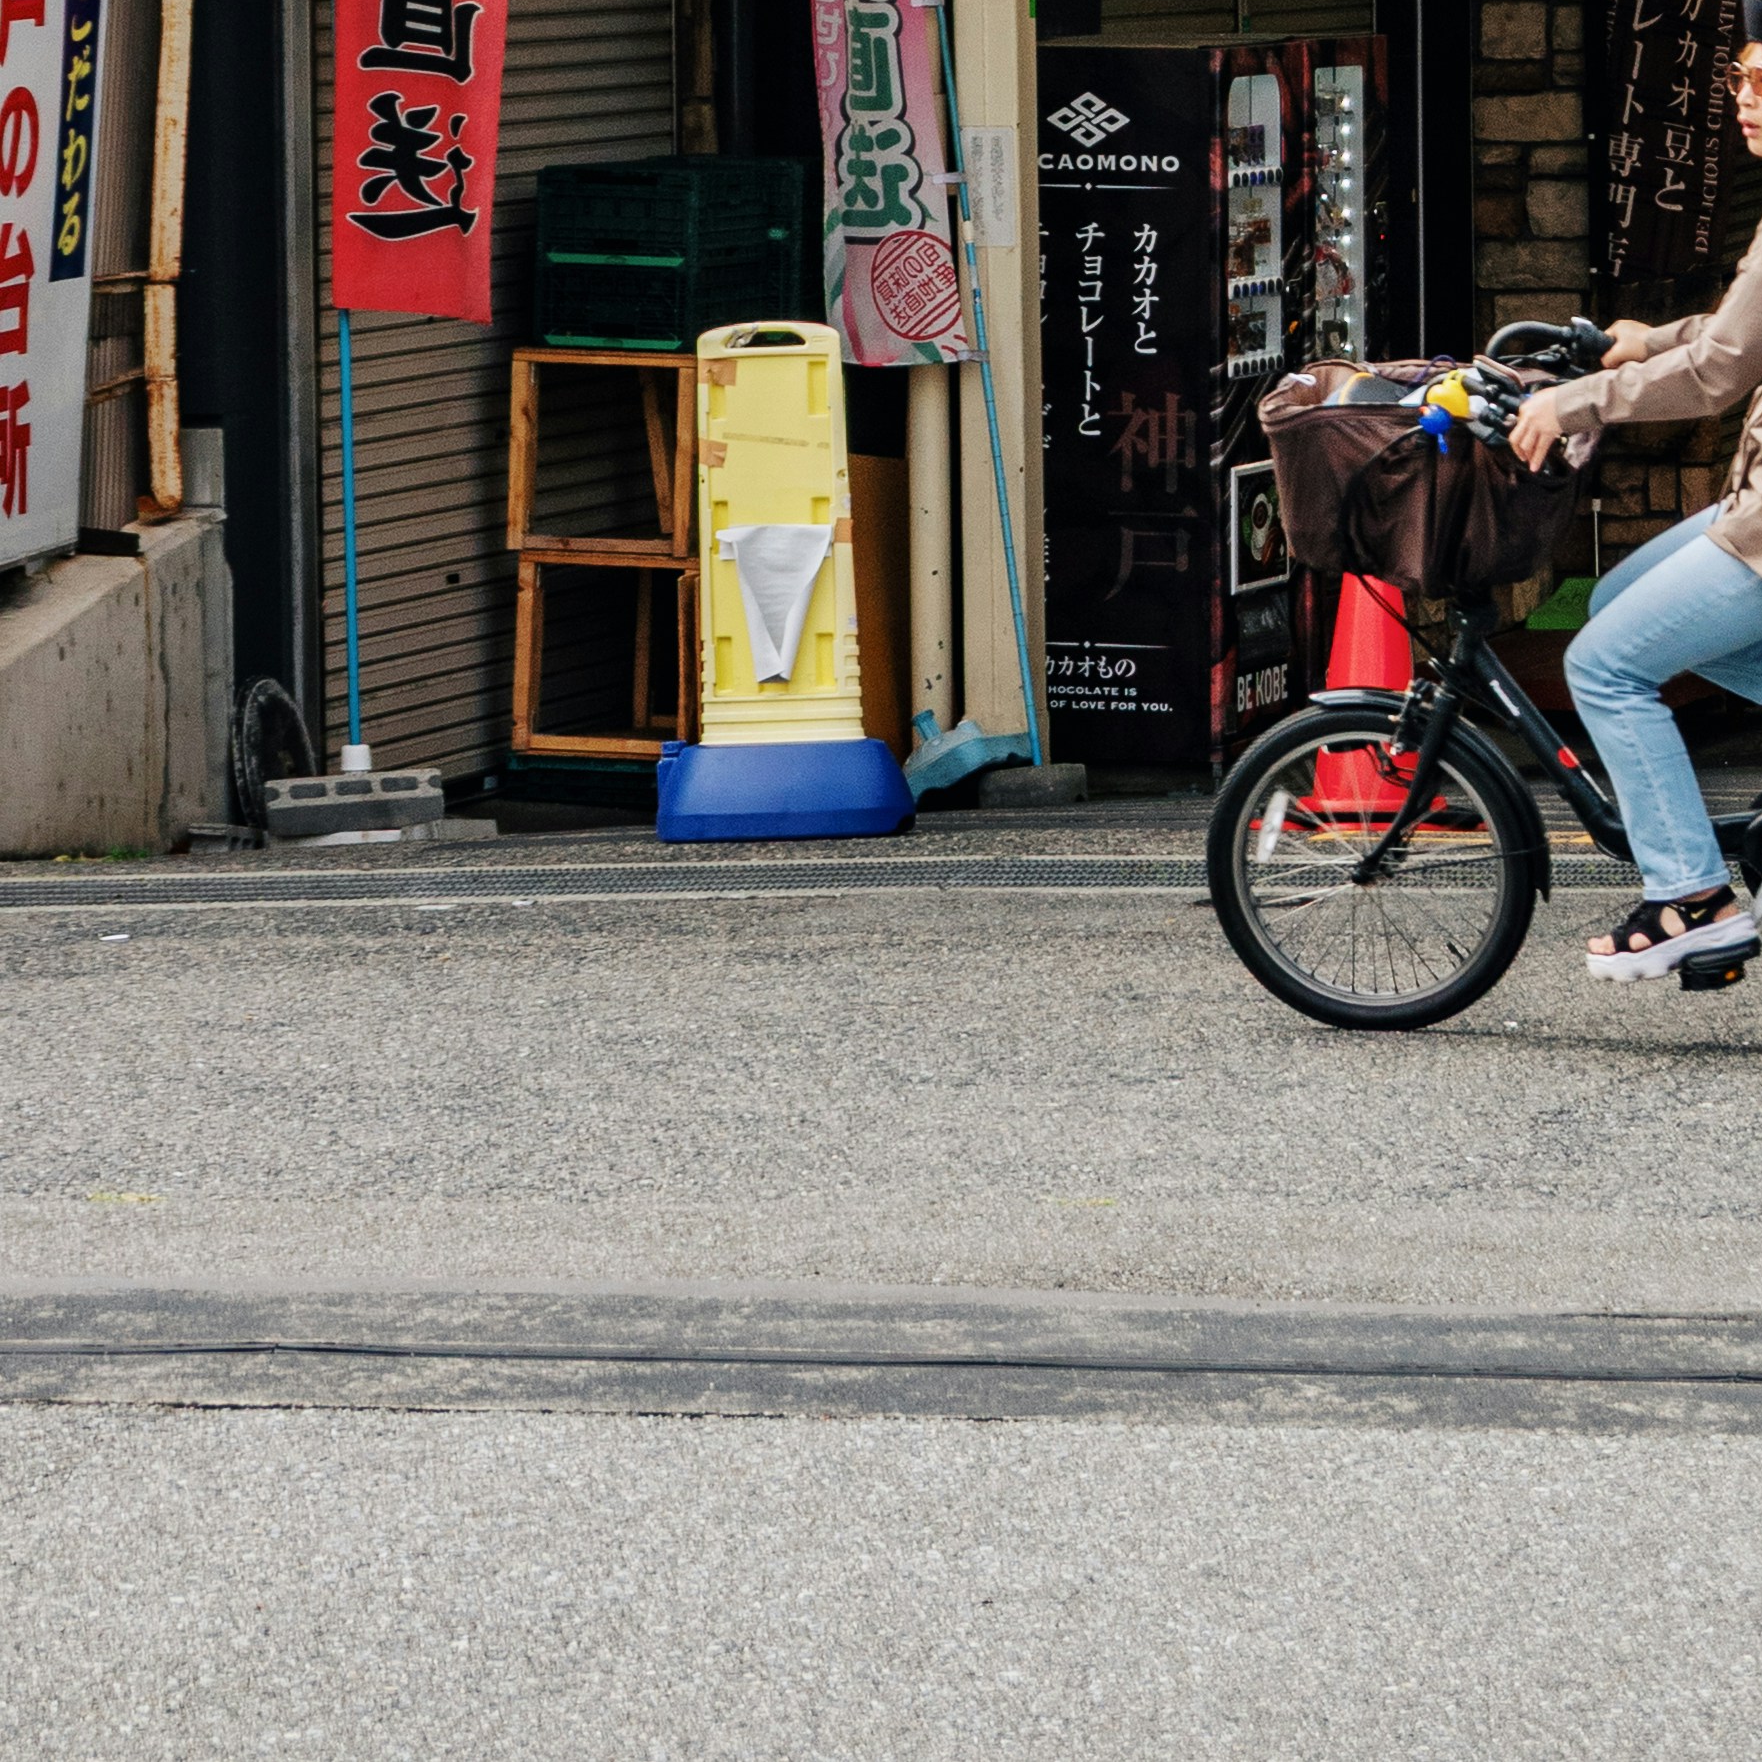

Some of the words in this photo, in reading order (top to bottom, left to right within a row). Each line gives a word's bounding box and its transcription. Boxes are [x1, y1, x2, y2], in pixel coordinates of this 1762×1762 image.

[1694, 137, 1720, 255] DELICIOUS
[1075, 222, 1106, 437] チョコレートと
[1130, 223, 1160, 355] カカオと
[1103, 391, 1200, 603] 神戸
[1050, 699, 1067, 710] OF
[1072, 699, 1106, 711] LOVE
[1110, 701, 1137, 711] FOR
[1142, 701, 1174, 713] YOU.
[1124, 686, 1137, 697] IS
[1238, 673, 1253, 713] BE
[1255, 663, 1288, 707] KOBE
